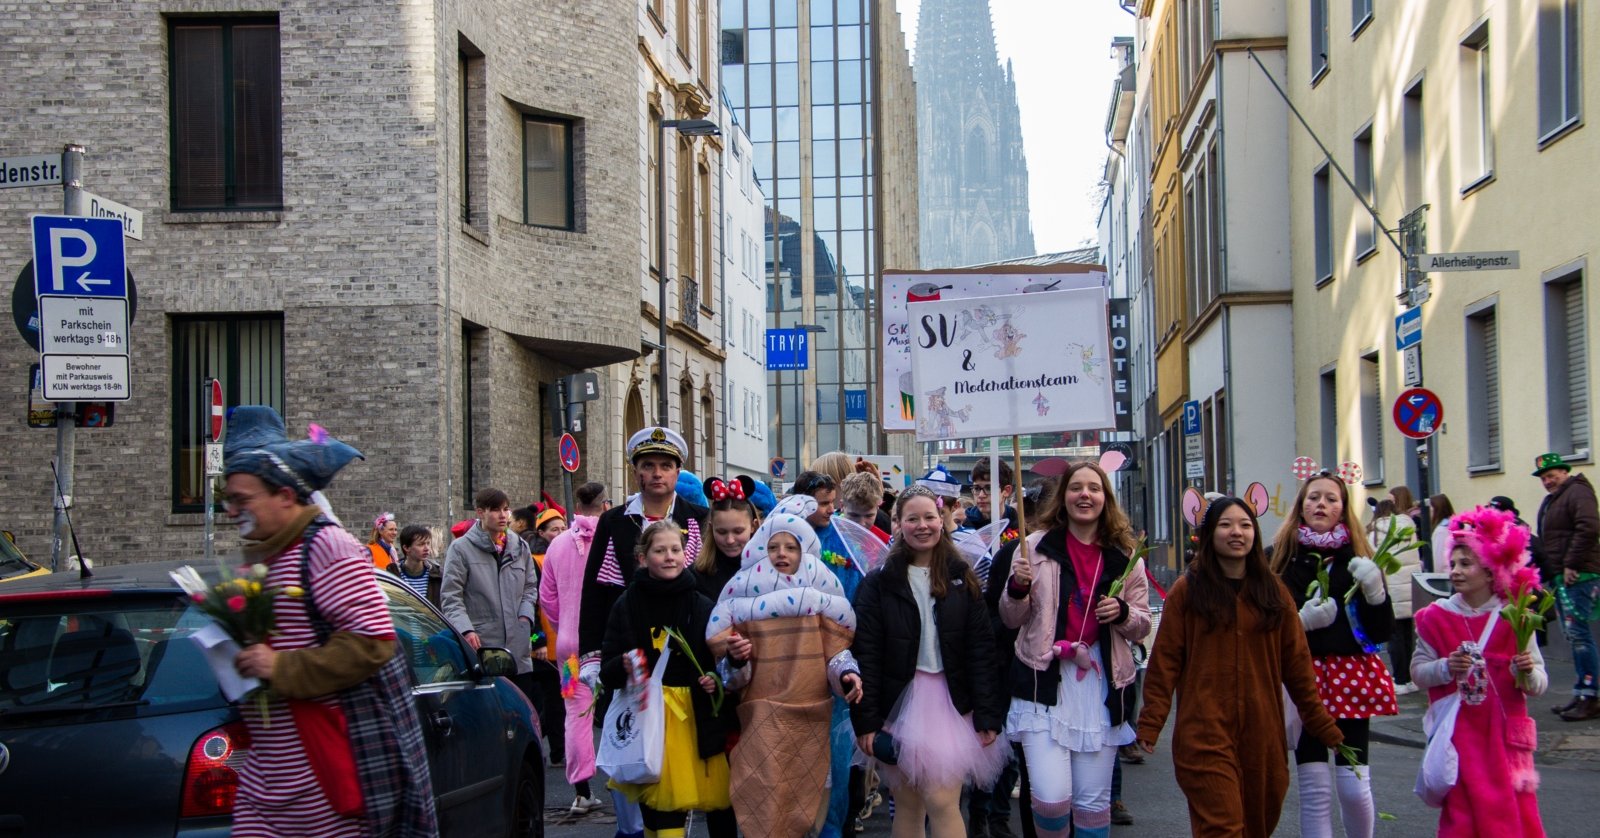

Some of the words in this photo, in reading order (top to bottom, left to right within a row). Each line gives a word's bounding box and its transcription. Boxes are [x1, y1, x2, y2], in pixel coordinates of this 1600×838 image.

[0, 160, 60, 184] denstr.
[49, 227, 97, 291] P
[1431, 255, 1512, 270] Allerheiligenstr.
[78, 306, 94, 316] mit
[61, 319, 112, 330] Parkschein
[917, 313, 957, 349] SV
[53, 333, 95, 346] werktags
[96, 333, 122, 344] 9-18h
[769, 334, 805, 351] TRYP
[65, 362, 102, 371] Bewohner
[961, 348, 976, 372] &
[1111, 314, 1128, 415] HOTEL
[69, 373, 113, 381] Parkausweis
[954, 373, 1080, 395] Moderationsteam
[70, 383, 102, 392] werktags
